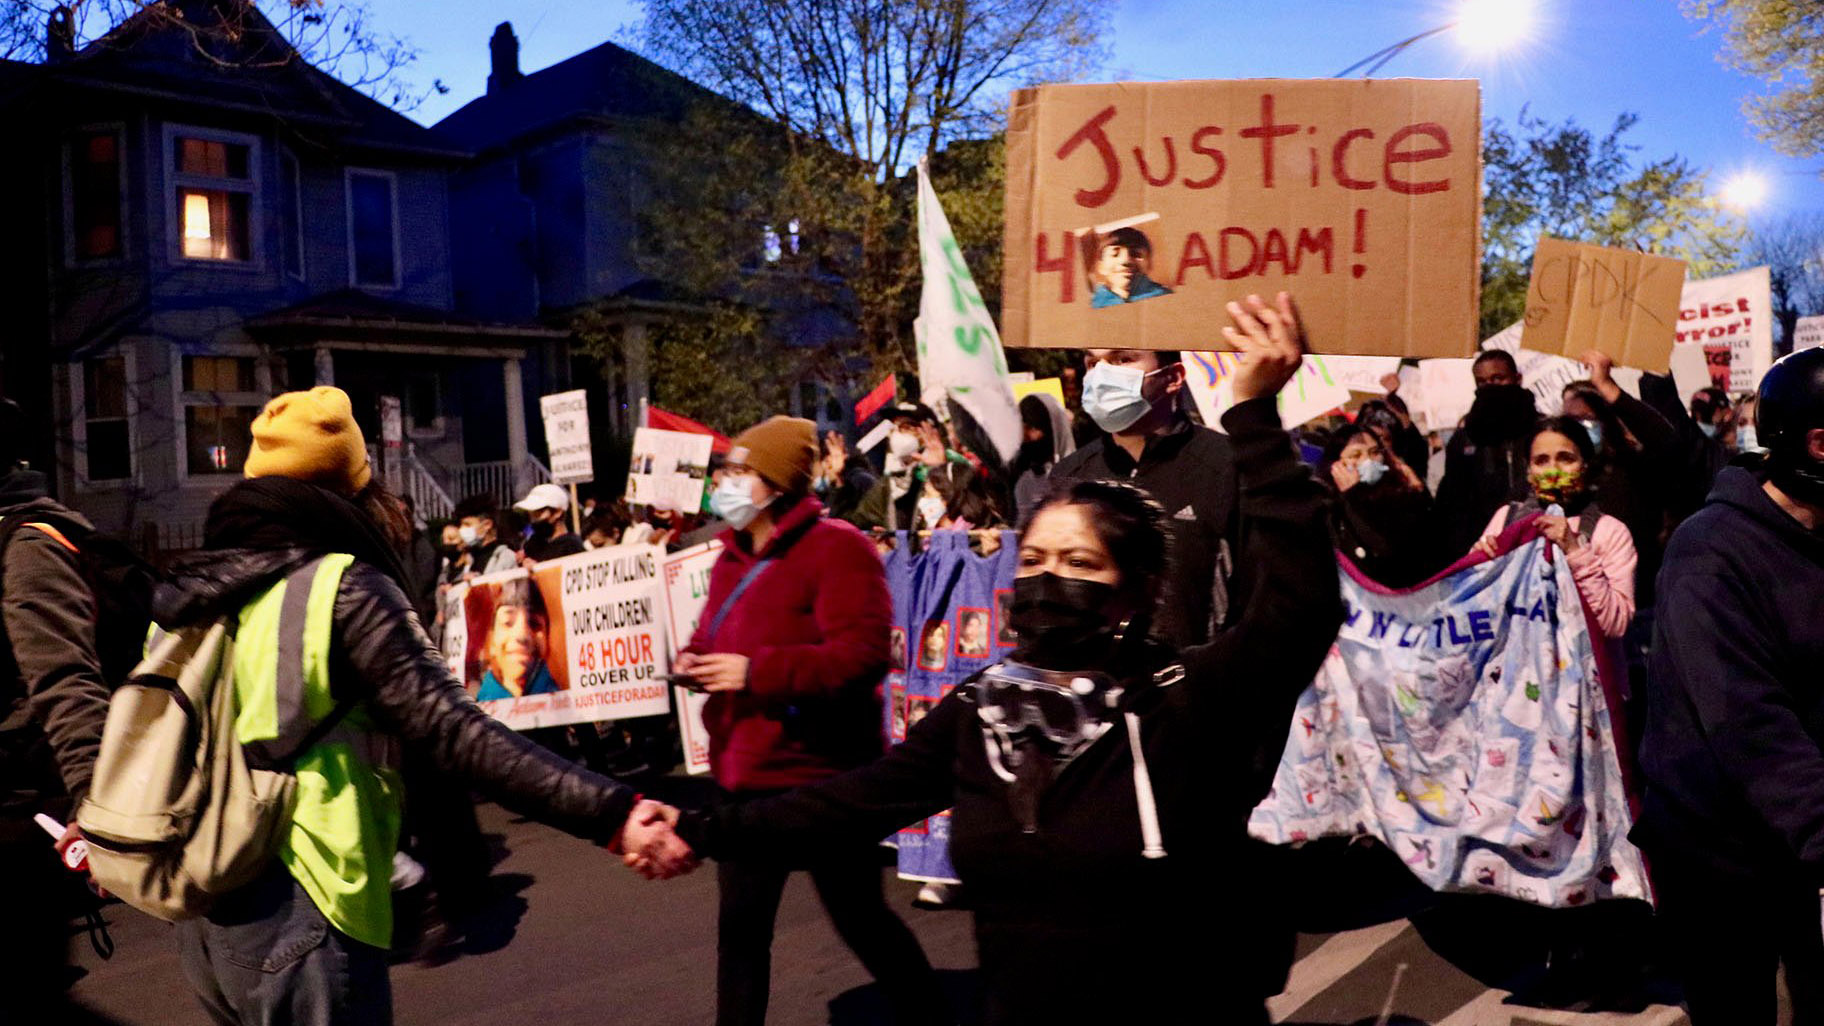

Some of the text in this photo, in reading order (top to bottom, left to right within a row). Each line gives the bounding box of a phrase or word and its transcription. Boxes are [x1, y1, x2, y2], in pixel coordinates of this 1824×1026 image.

[1056, 94, 1451, 207] Justice
[1036, 231, 1076, 303] 4
[566, 566, 583, 595] CPD
[586, 561, 609, 590] STOP
[613, 553, 656, 585] KILLING
[573, 608, 592, 636] OUR
[579, 633, 654, 672] 48 HOUR
[580, 665, 655, 688] COVER UP
